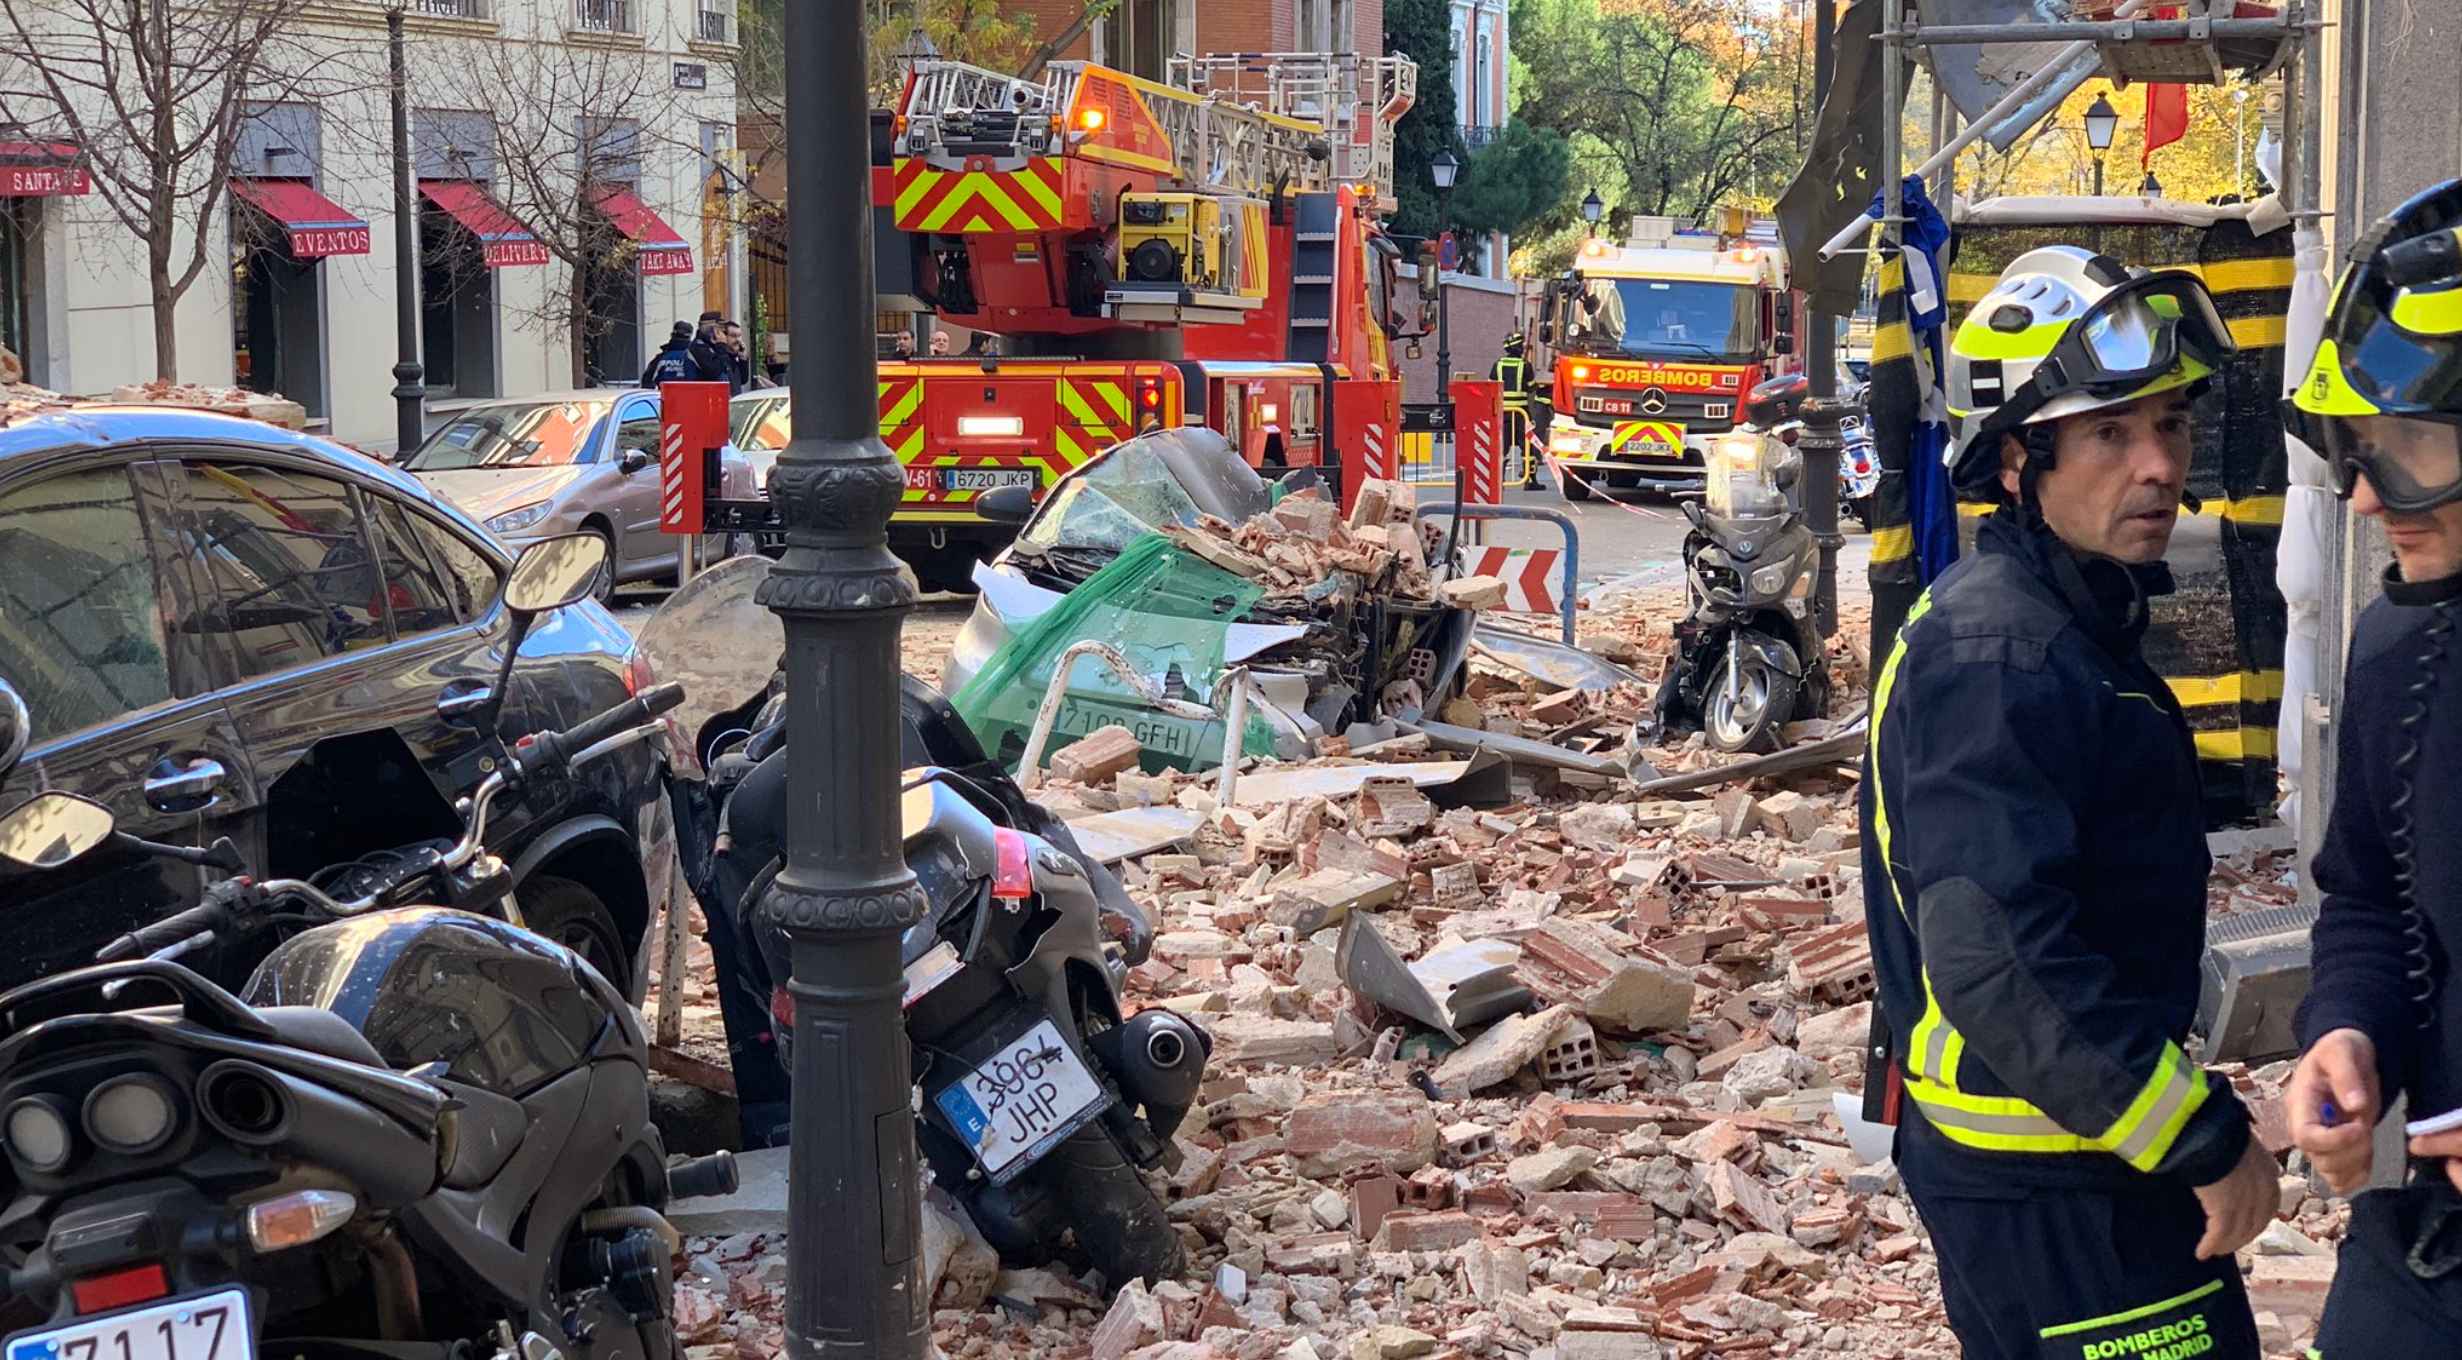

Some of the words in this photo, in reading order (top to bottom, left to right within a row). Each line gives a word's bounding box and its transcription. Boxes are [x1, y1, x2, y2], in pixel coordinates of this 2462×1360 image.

[13, 171, 62, 191] SANTA
[294, 231, 369, 253] EVENTOS
[484, 243, 547, 262] DELIVERY
[641, 252, 664, 270] TAKE
[666, 251, 692, 269] AWAY
[1620, 402, 1631, 413] 11
[957, 473, 996, 487] 6720
[1001, 473, 1030, 487] JKP
[1134, 721, 1180, 750] GFH
[976, 1034, 1063, 1110] 3964
[1008, 1082, 1058, 1143] JHP
[967, 1117, 982, 1132] E
[2083, 1314, 2208, 1360] BOMBEROS
[2142, 1333, 2214, 1360] MADRID
